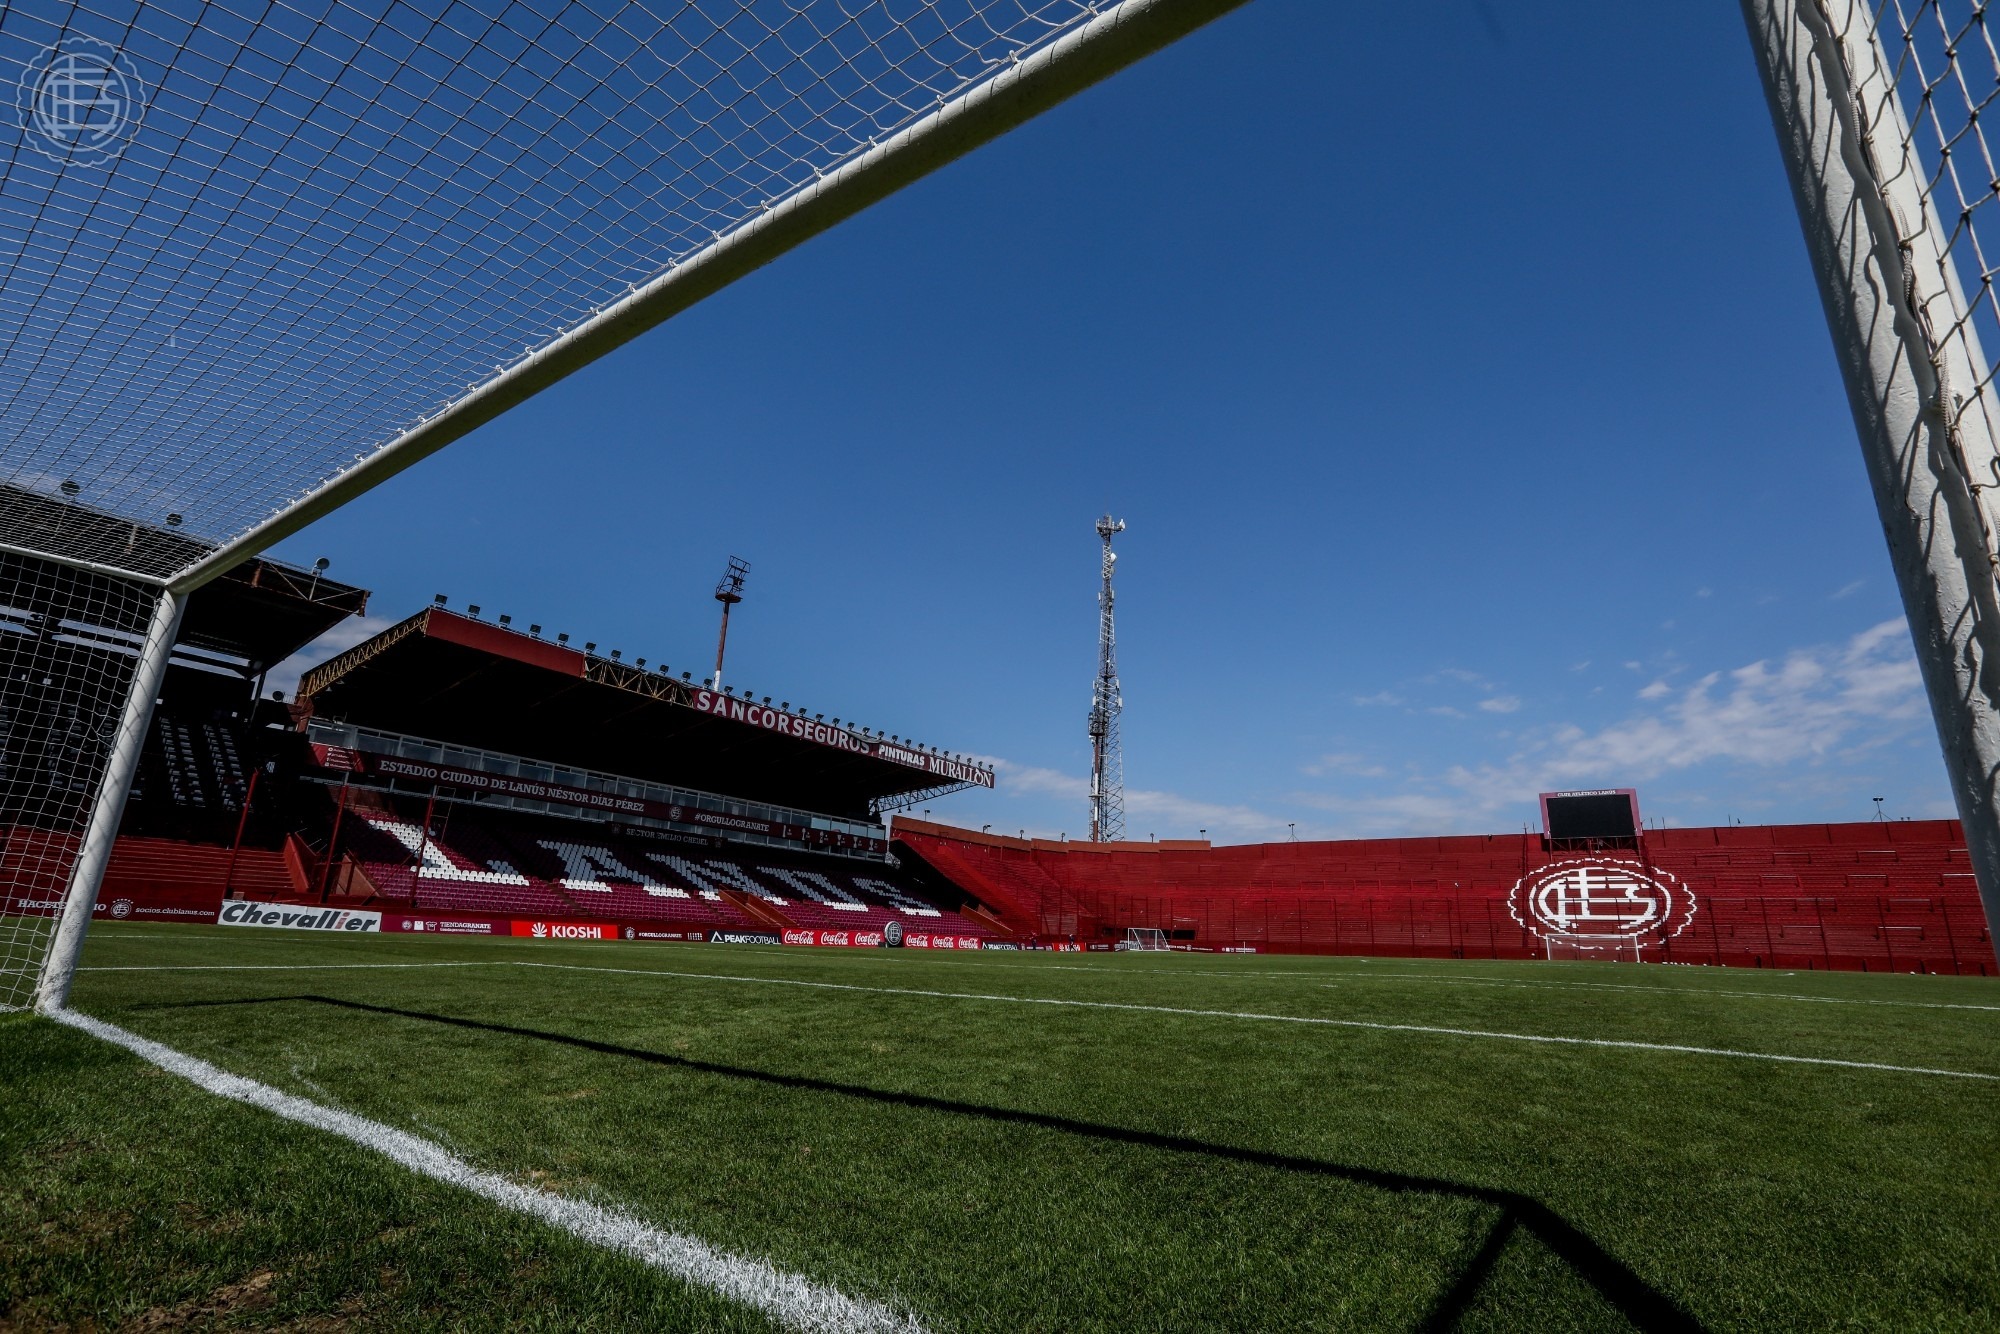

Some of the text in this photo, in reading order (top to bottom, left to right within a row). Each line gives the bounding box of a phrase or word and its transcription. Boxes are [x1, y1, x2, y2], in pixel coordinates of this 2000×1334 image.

[878, 744, 925, 767] PINTURAS
[379, 760, 645, 813] ESTADIO CIUDAD DE LANÚS NÉSTOR DÍAZ PÉREZ
[694, 812, 770, 833] #ORGULLOGRANATE
[222, 904, 378, 932] Chevallier
[551, 925, 602, 939] KIOSHI
